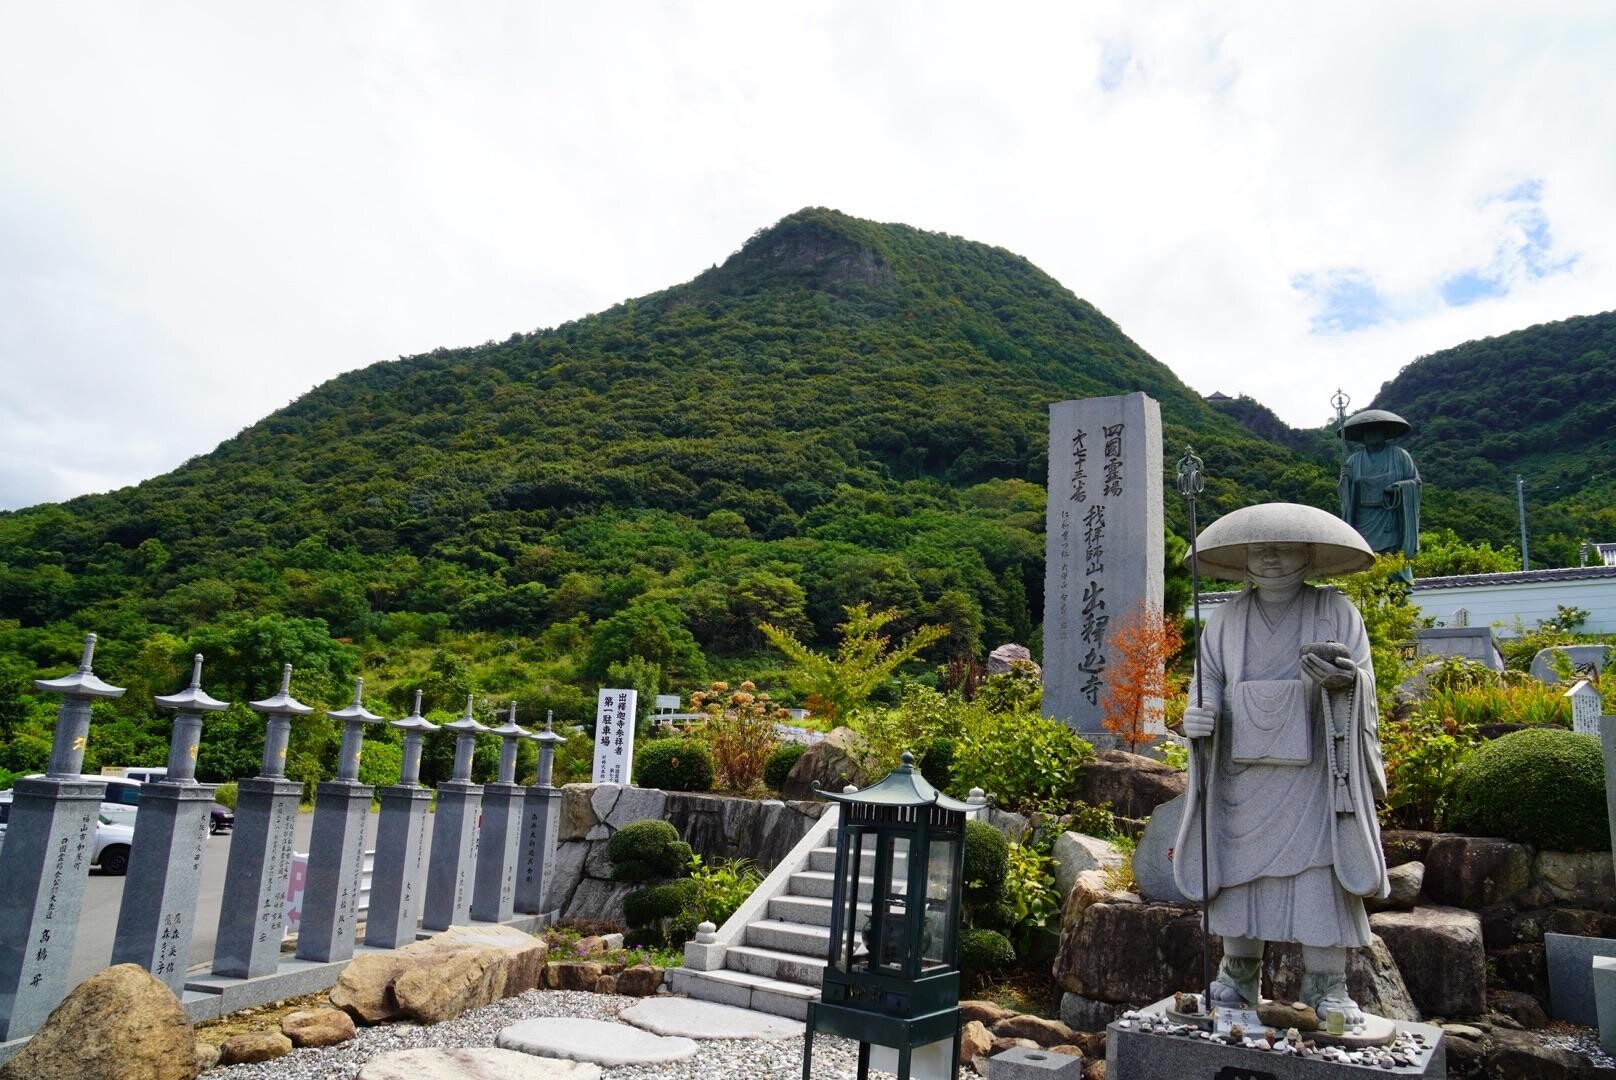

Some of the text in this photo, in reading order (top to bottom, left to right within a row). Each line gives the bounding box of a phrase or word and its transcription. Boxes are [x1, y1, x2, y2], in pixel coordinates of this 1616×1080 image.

[600, 696, 614, 747] 第一駐車場
